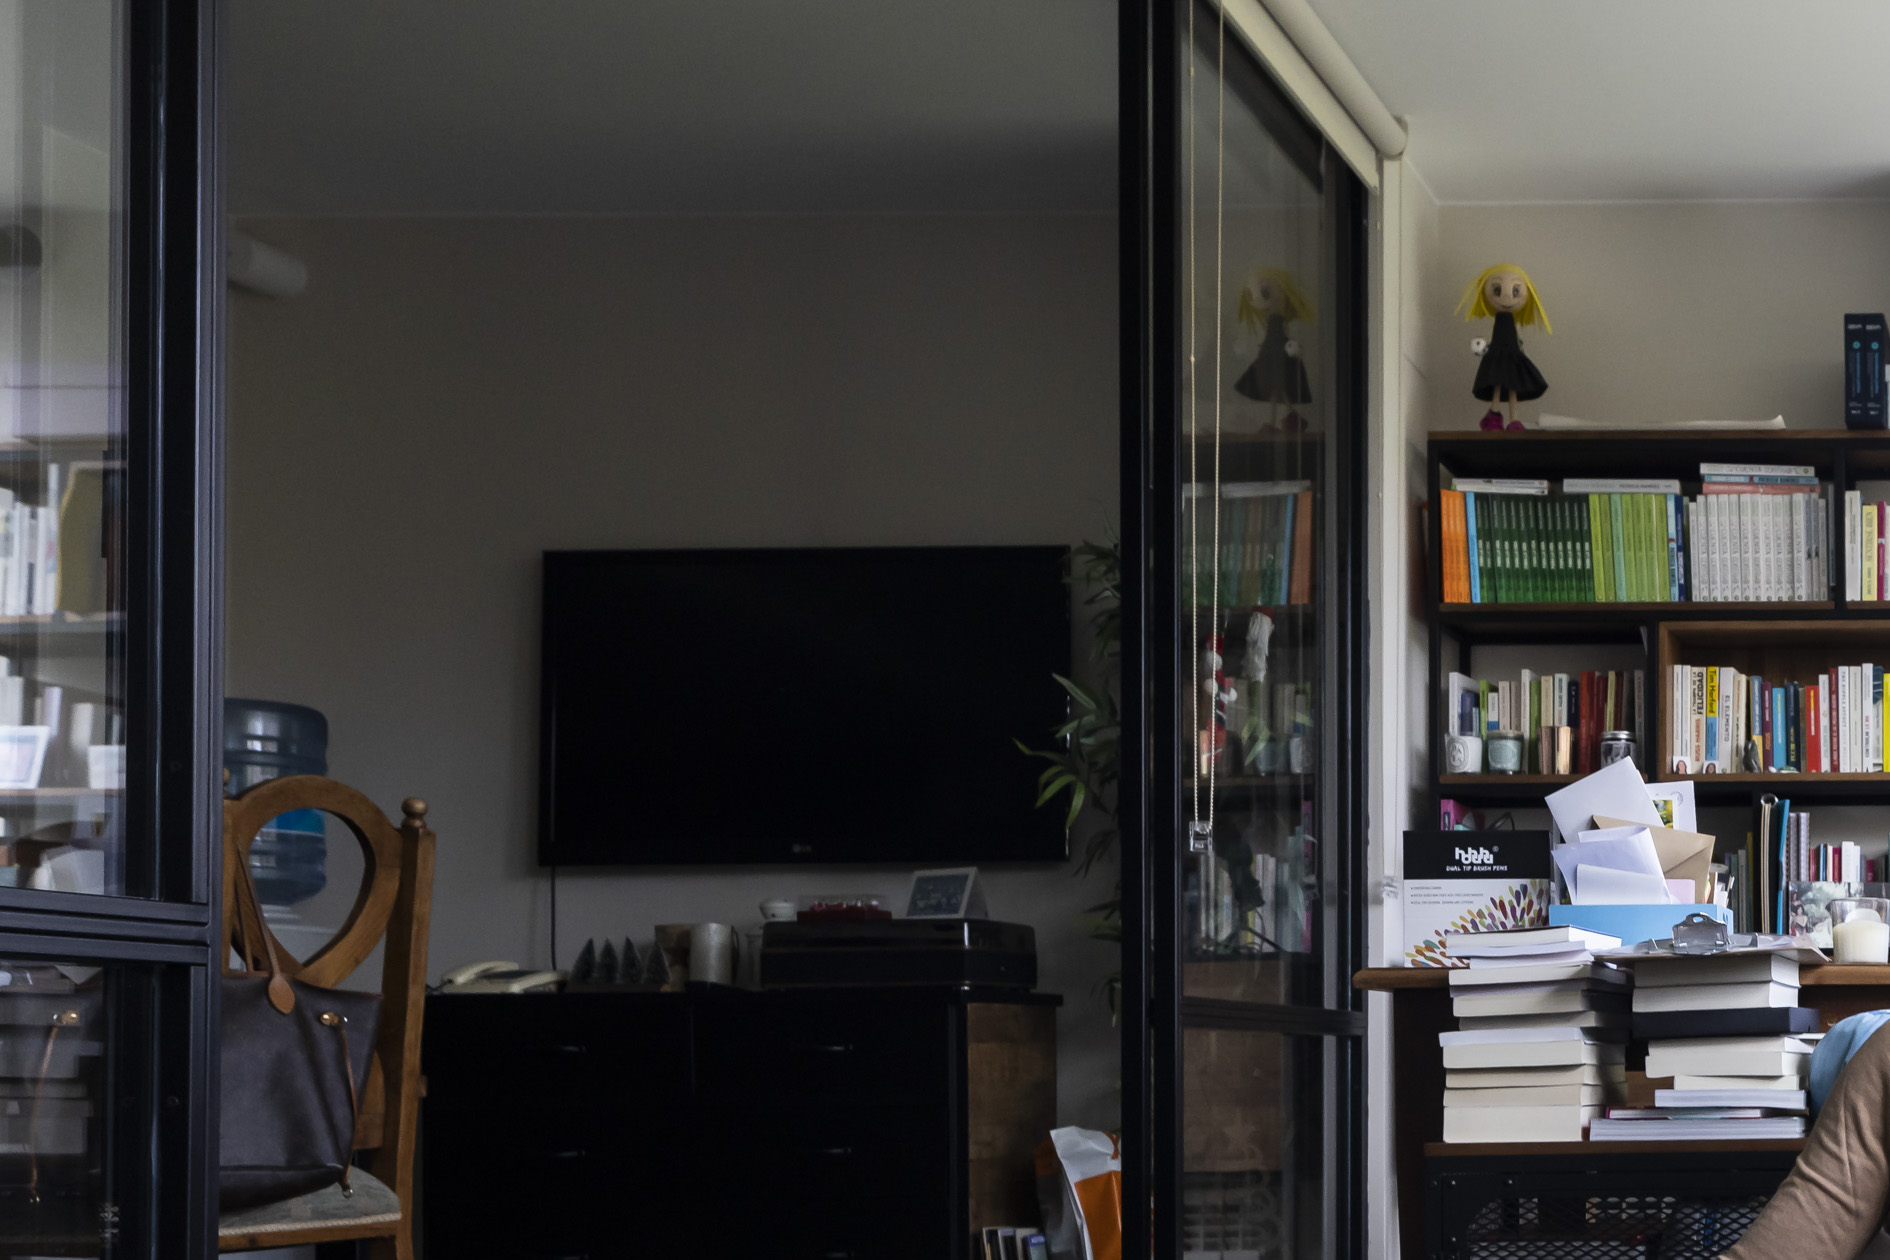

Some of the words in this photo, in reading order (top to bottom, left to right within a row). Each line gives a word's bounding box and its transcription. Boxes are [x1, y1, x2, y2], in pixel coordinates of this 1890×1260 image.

[1709, 669, 1717, 683] Tim
[1696, 671, 1704, 715] FELICIDAD
[1709, 685, 1717, 713] Harford
[1724, 695, 1730, 703] EL
